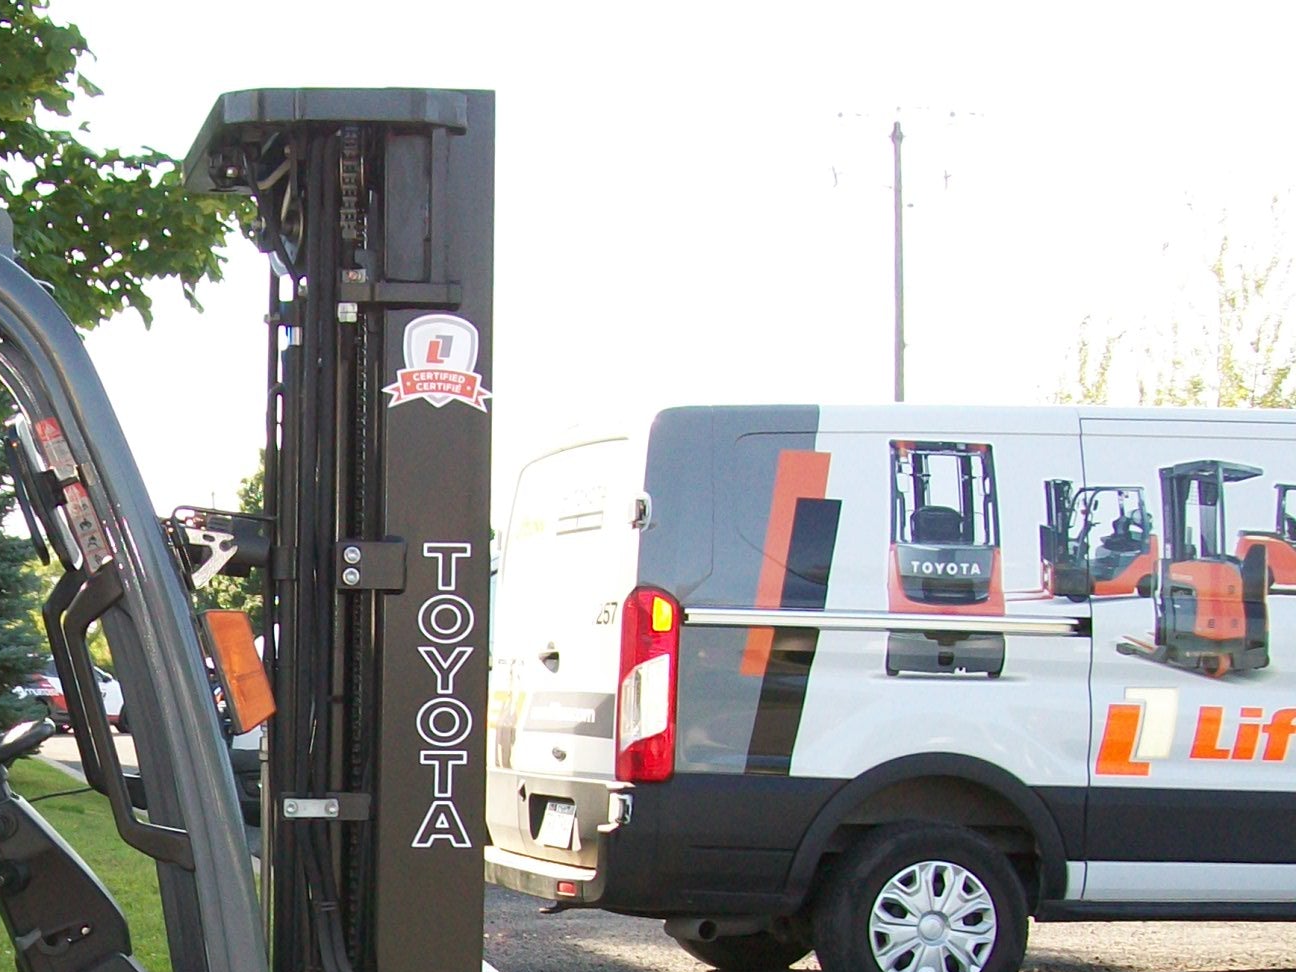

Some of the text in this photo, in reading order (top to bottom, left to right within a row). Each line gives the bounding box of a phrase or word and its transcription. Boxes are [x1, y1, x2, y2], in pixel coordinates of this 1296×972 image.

[413, 372, 465, 384] CERTIFIED
[416, 382, 462, 393] CERTIFIÉ
[910, 560, 982, 575] TOYOTA
[412, 543, 474, 847] TOYOTA
